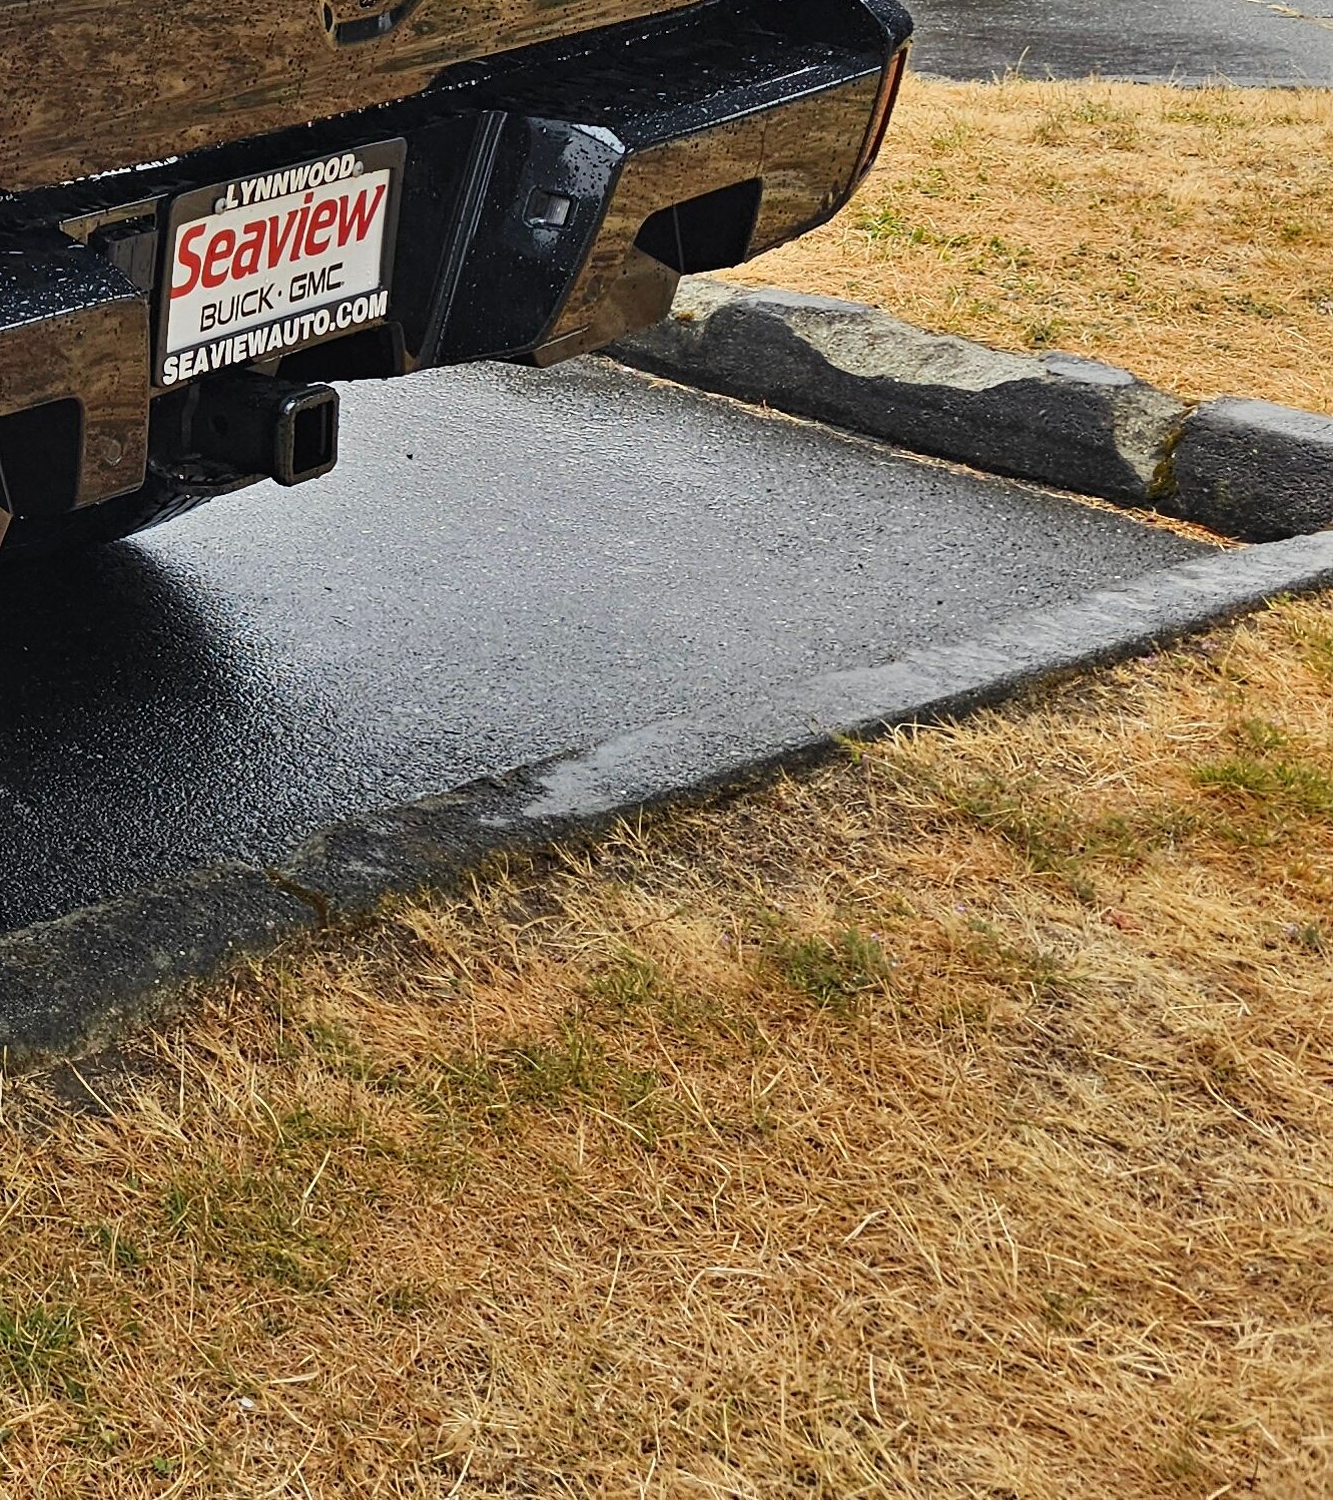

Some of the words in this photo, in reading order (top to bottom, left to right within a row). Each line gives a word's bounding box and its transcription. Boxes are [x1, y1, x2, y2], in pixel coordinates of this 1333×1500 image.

[225, 153, 356, 210] LYNNWOOD
[170, 183, 387, 300] Seaview
[161, 290, 389, 386] SEAVIEWAUTO.COM
[199, 287, 274, 333] BUICK
[288, 262, 345, 301] GMC
